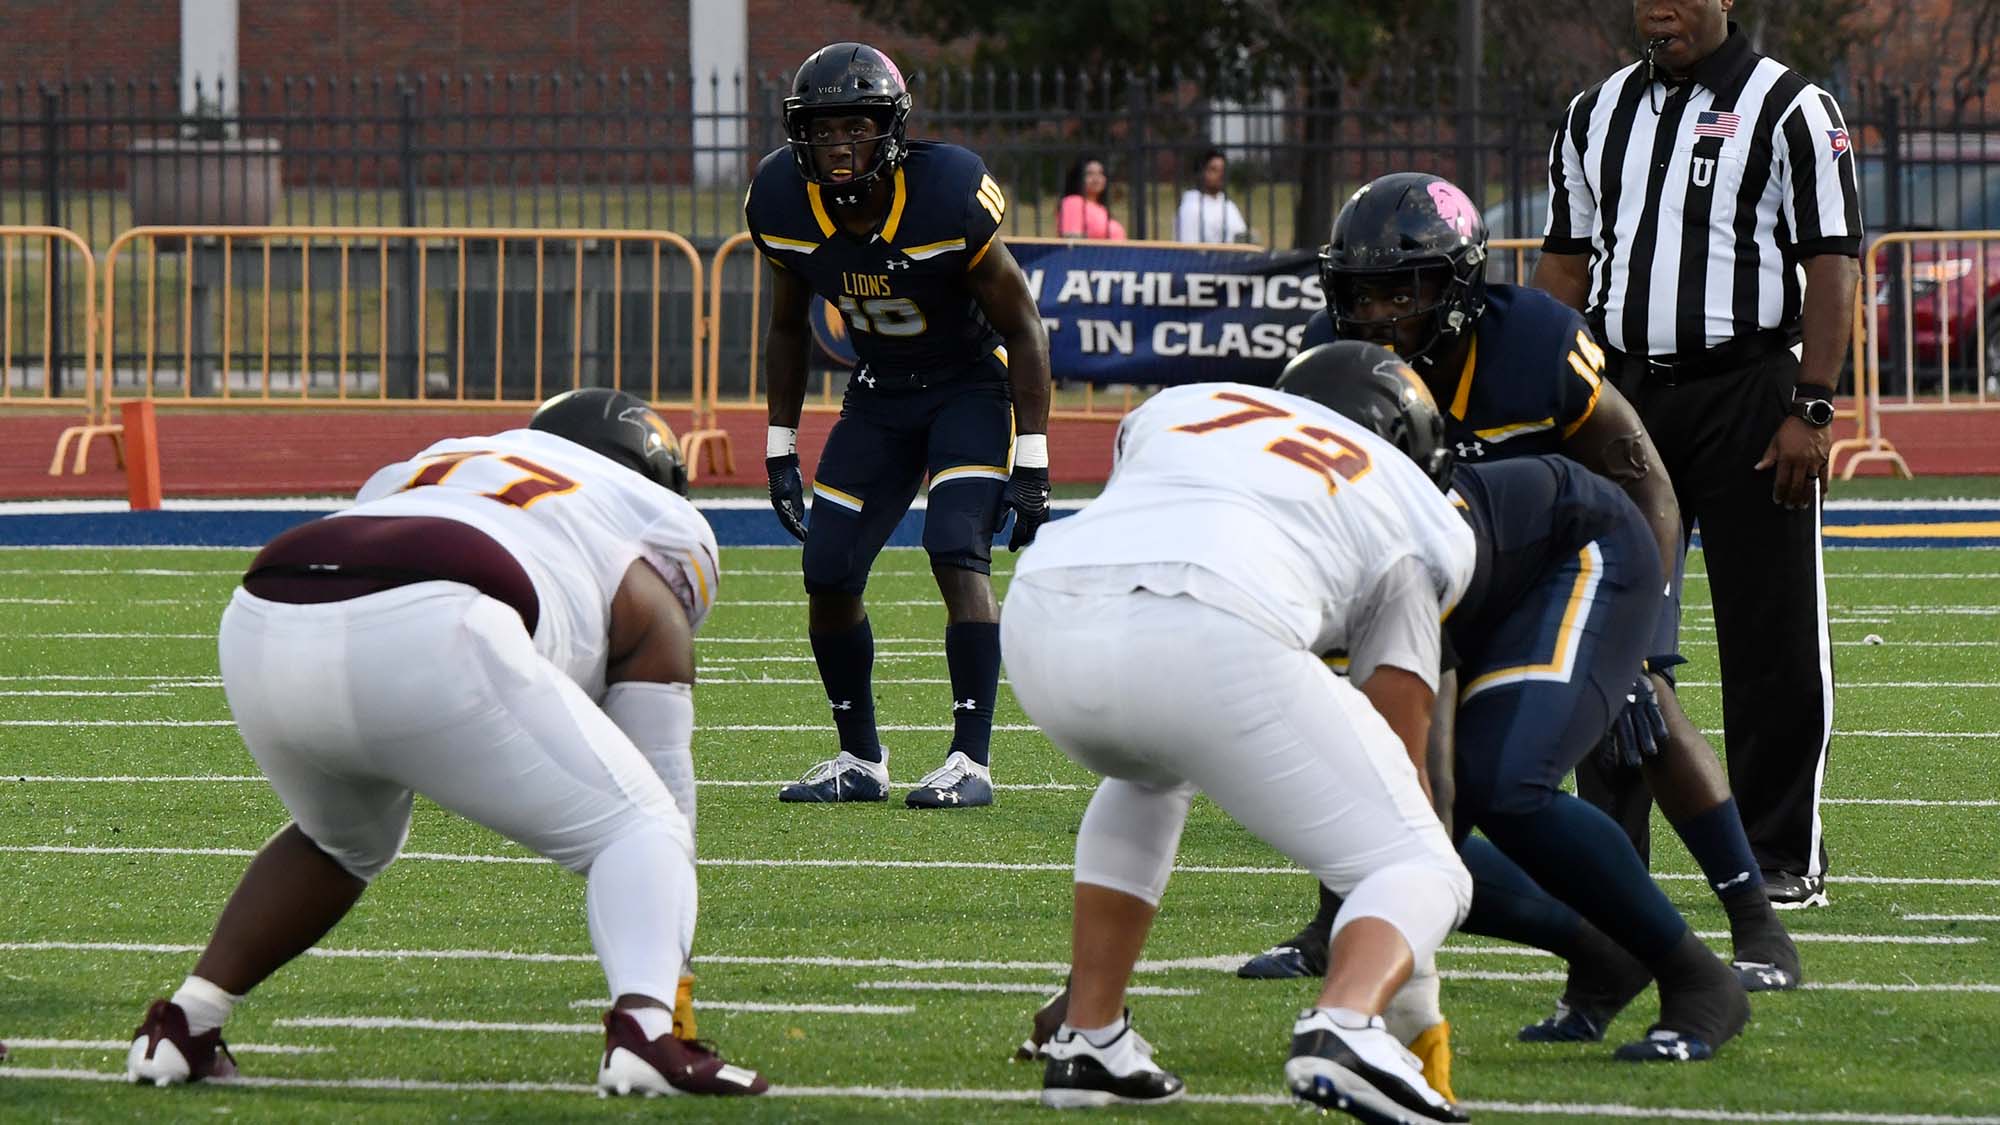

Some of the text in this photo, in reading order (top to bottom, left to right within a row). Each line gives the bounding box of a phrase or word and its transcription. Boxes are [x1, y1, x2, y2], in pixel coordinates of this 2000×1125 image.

[818, 86, 842, 95] VICIS
[1692, 157, 1715, 188] U
[976, 174, 1006, 225] 10
[842, 271, 891, 297] LIONS
[1057, 270, 1327, 311] ATHLETICS
[838, 295, 928, 336] 10
[1077, 320, 1133, 355] IN
[1167, 392, 1373, 496] 72
[401, 450, 582, 510] 77
